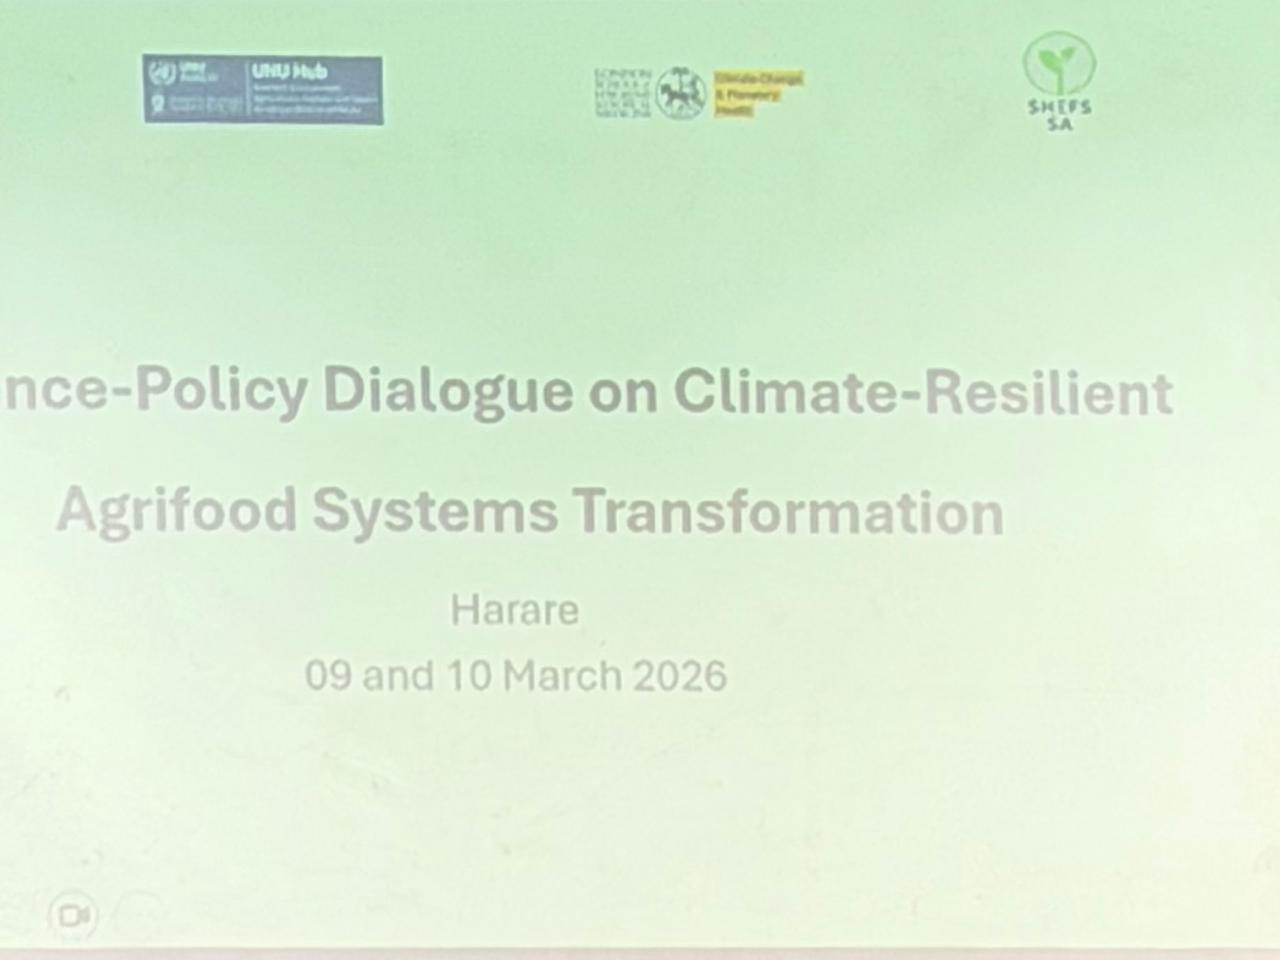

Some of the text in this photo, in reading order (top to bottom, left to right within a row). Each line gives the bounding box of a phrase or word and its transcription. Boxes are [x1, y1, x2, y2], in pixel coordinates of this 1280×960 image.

[324, 364, 574, 424] Dialogue
[589, 378, 658, 413] on
[674, 366, 1174, 416] Climate-Resilient
[56, 484, 1003, 544] Agrifood Systems Transformation
[452, 594, 579, 625] Harare
[305, 659, 728, 692] 09 and 10 March 2026
